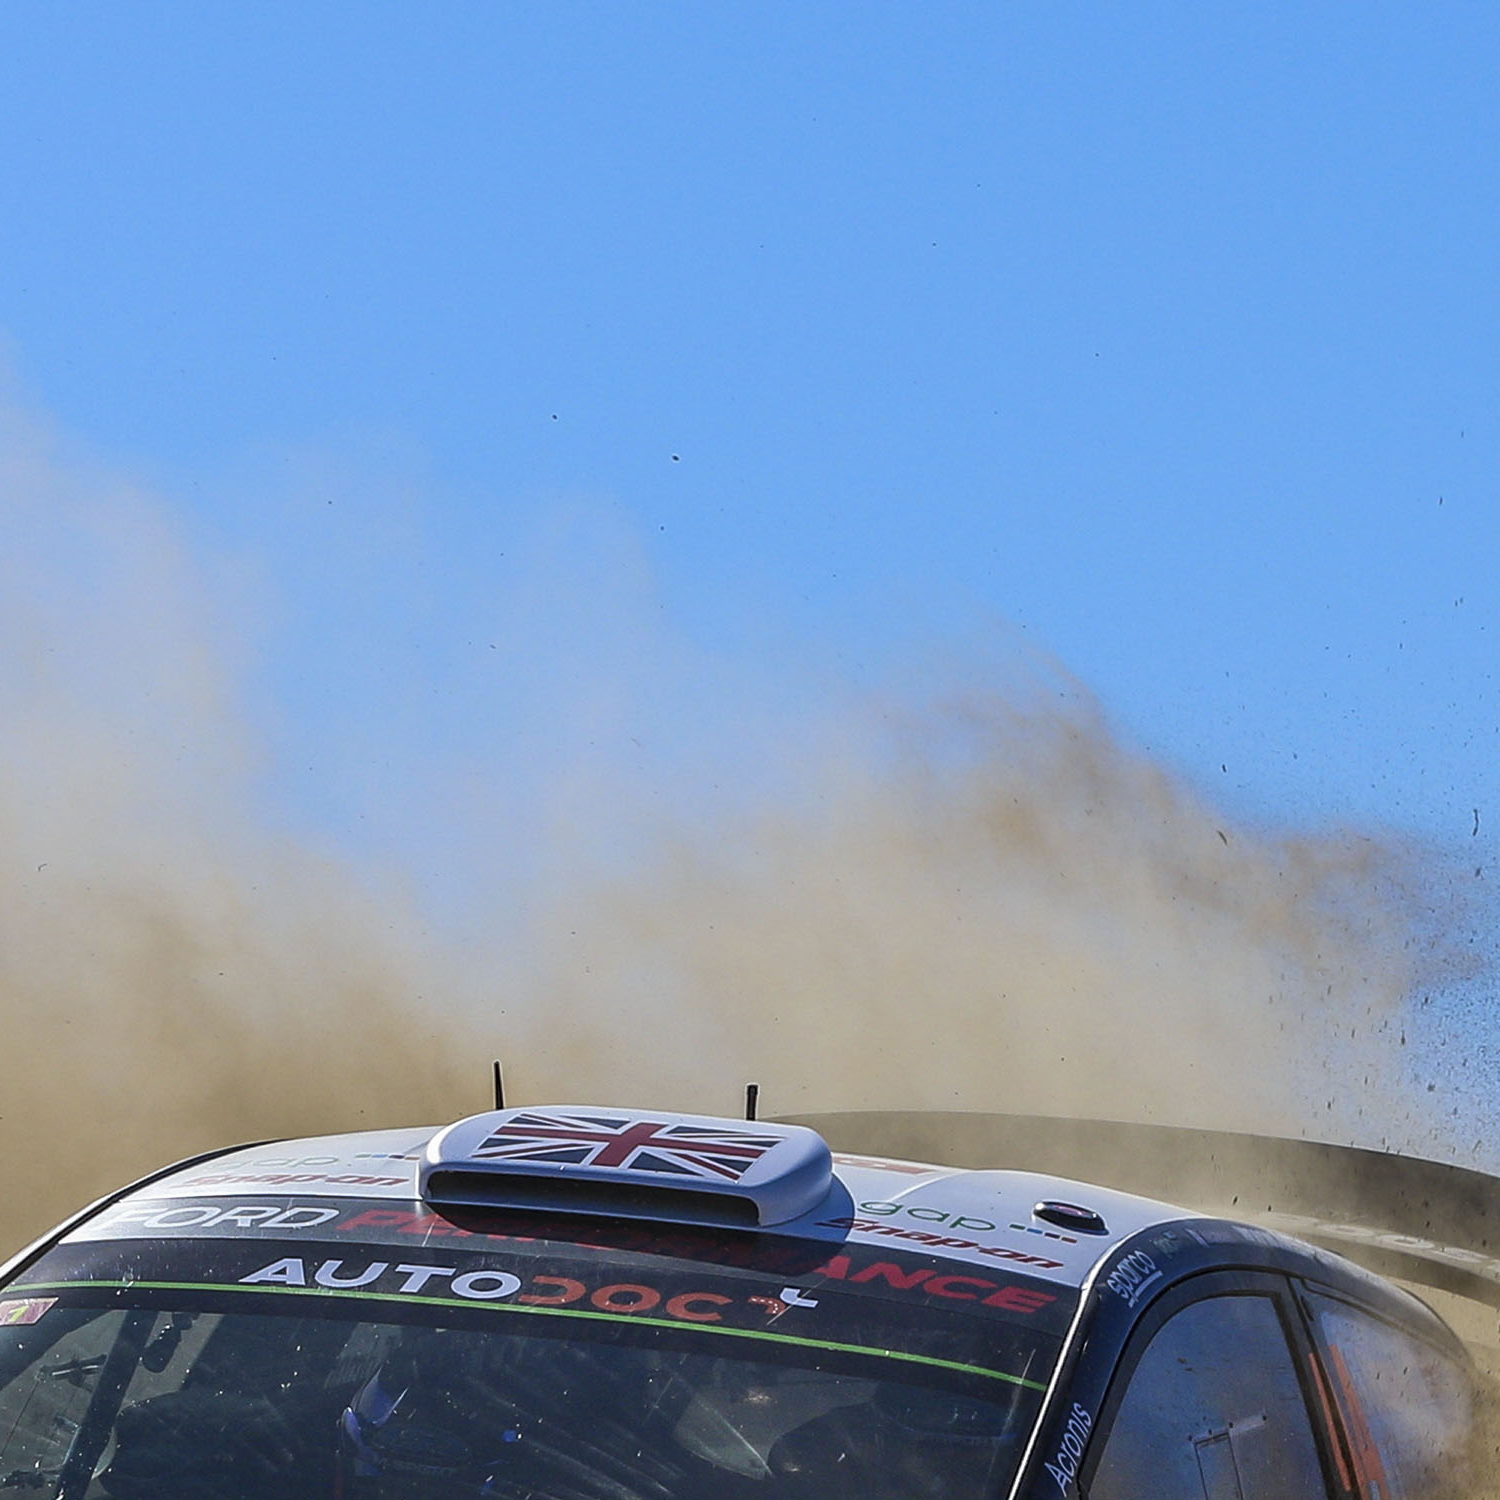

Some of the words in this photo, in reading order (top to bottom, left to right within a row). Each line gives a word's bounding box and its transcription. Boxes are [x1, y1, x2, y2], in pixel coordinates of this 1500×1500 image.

[100, 1206, 340, 1228] FORD
[858, 1202, 996, 1231] gap
[815, 1217, 1064, 1269] snap-on
[239, 1258, 732, 1321] AUTODOC
[1106, 1250, 1158, 1300] sparco
[1044, 1402, 1092, 1498] Acronis
